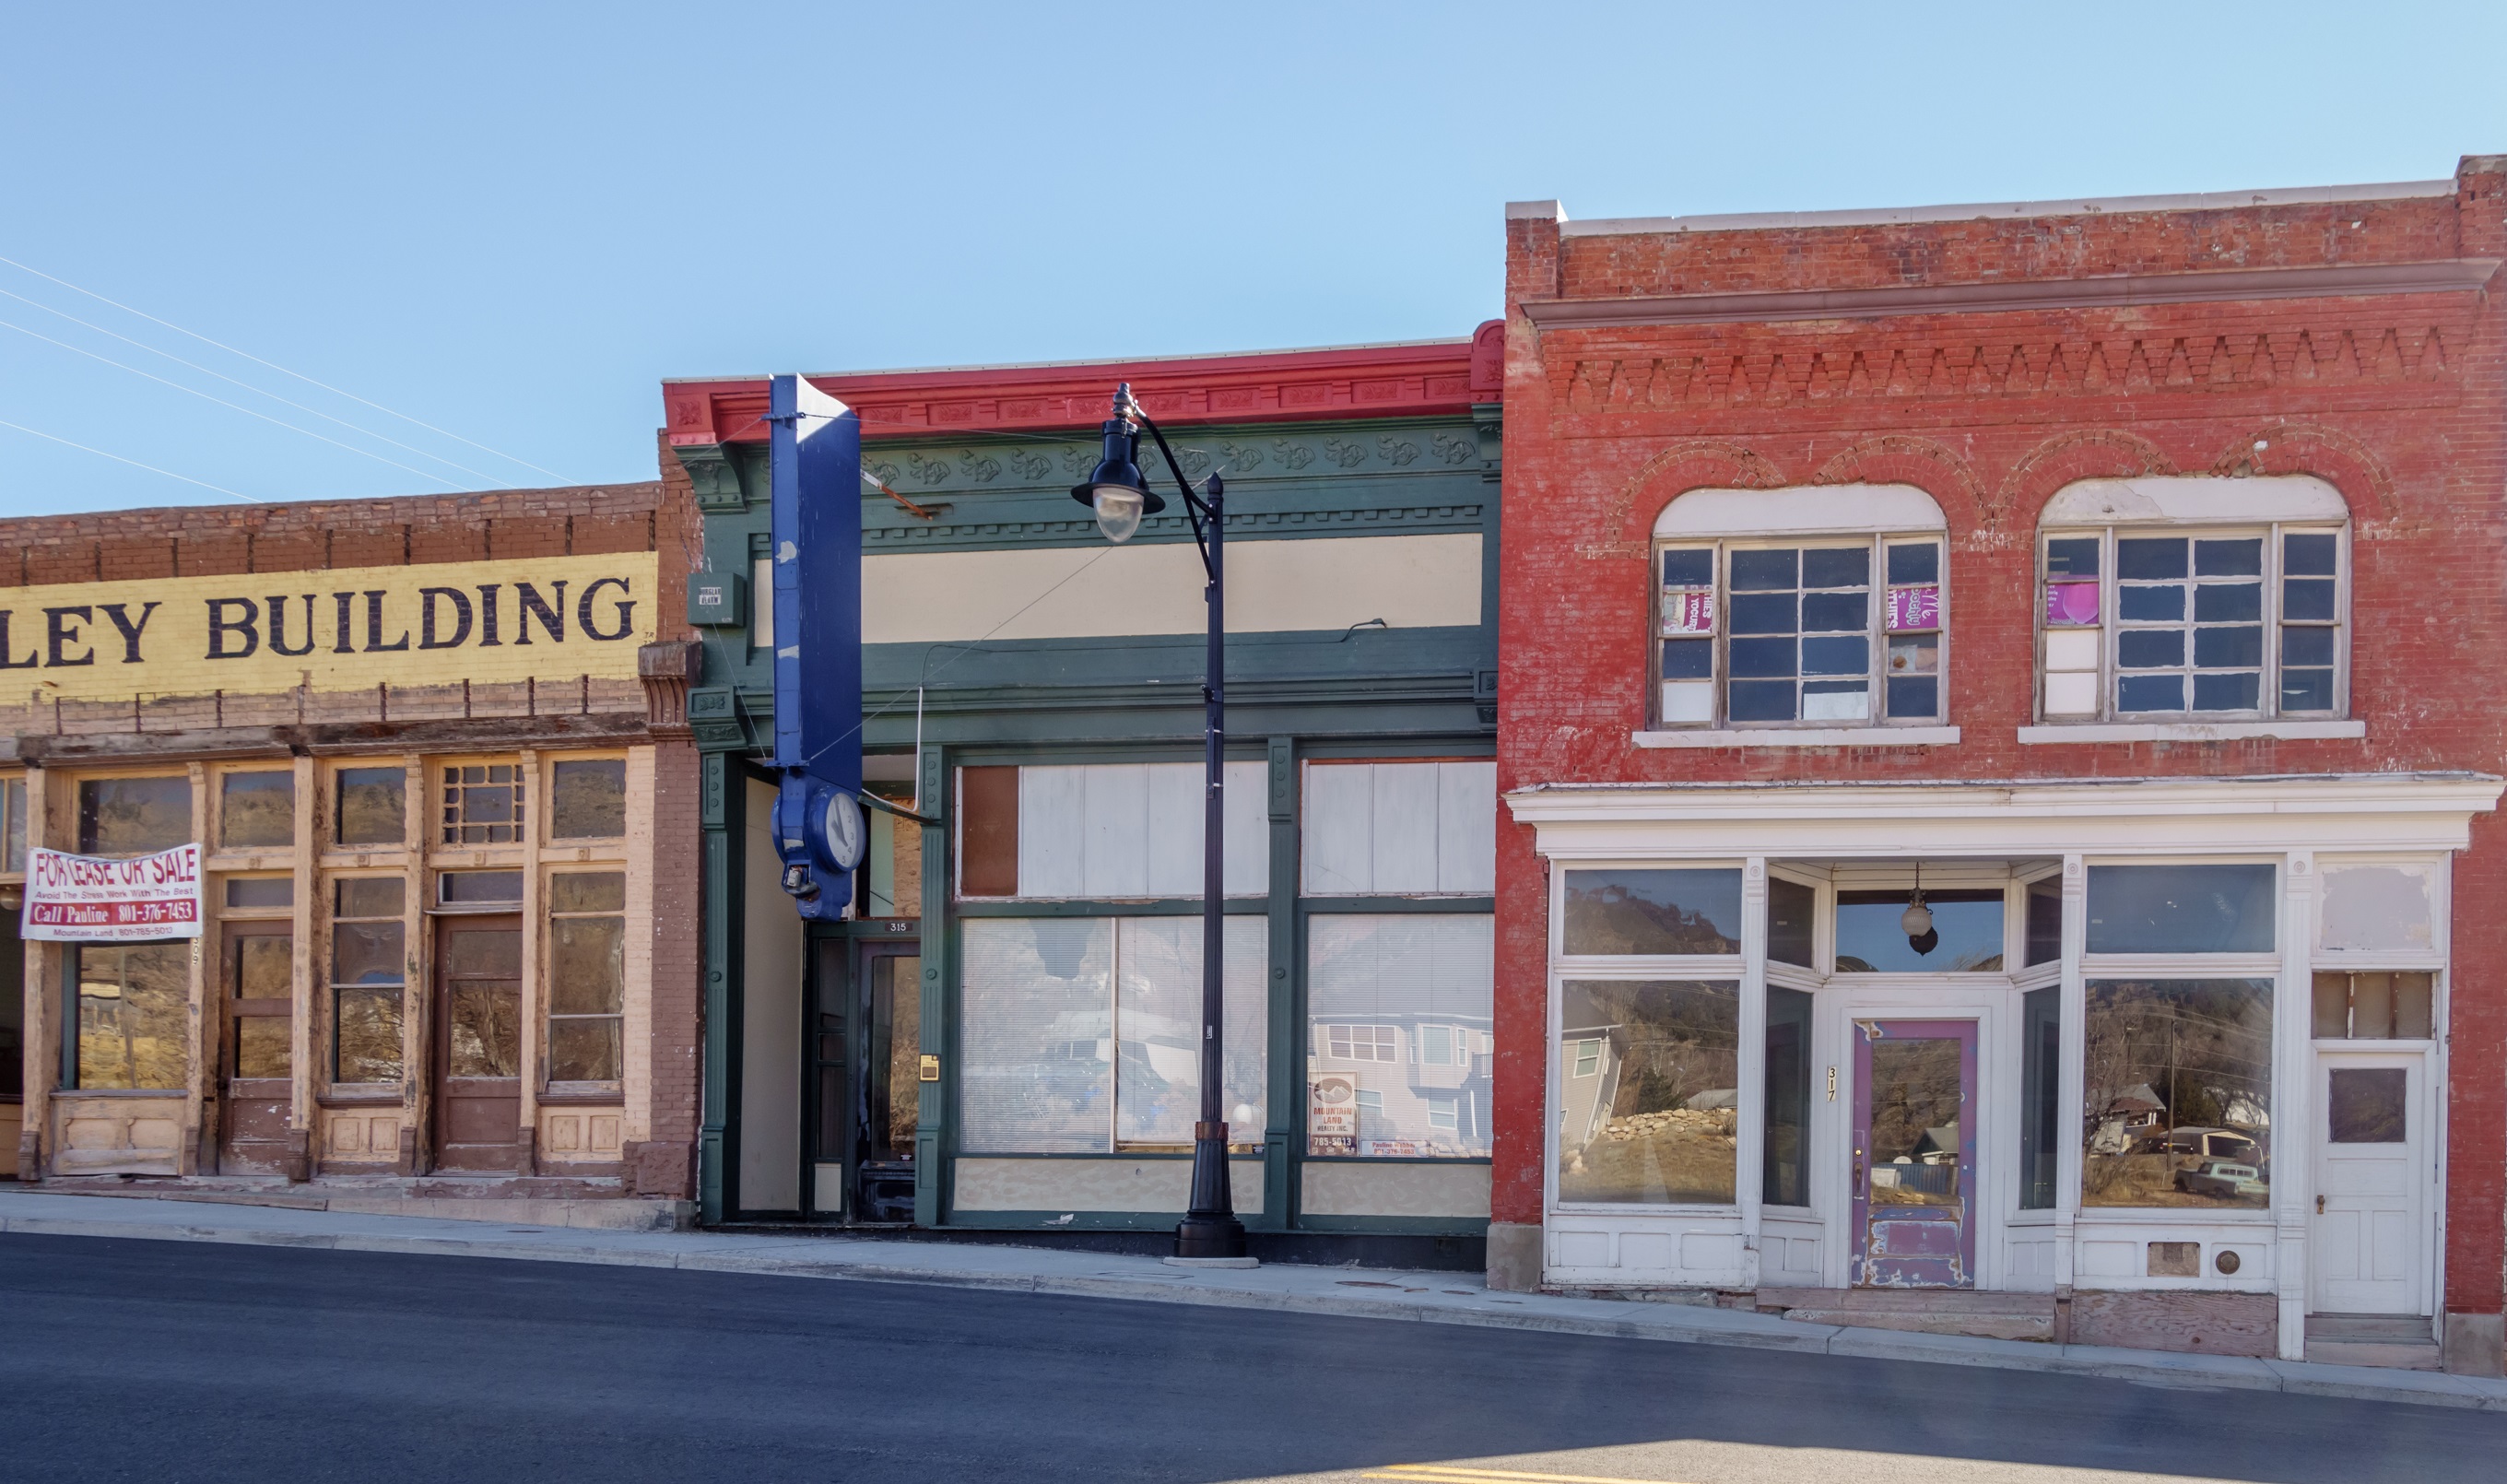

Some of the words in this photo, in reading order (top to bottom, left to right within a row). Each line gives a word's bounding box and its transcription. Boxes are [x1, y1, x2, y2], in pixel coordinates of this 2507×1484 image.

[0, 601, 162, 669] LEY
[205, 577, 638, 659] BUILDING
[36, 853, 67, 887] FOR
[67, 857, 115, 886] LEASE
[120, 859, 146, 885] OR
[151, 849, 195, 884] SALE
[35, 890, 61, 899] Avoid
[81, 890, 103, 899] Stress
[106, 889, 127, 898] Work
[130, 889, 151, 897] With
[154, 888, 171, 896] The
[173, 887, 194, 895] Best
[34, 904, 63, 923] Call
[66, 905, 109, 923] Pauline
[118, 901, 193, 924] 801-376-7453
[53, 928, 92, 936] Mountain
[118, 926, 173, 936] 801-785-5013
[890, 923, 906, 932] 315
[1313, 1107, 1352, 1115] MOUNTAIN
[1323, 1116, 1342, 1125] LAND
[1313, 1137, 1352, 1146] 785-5013
